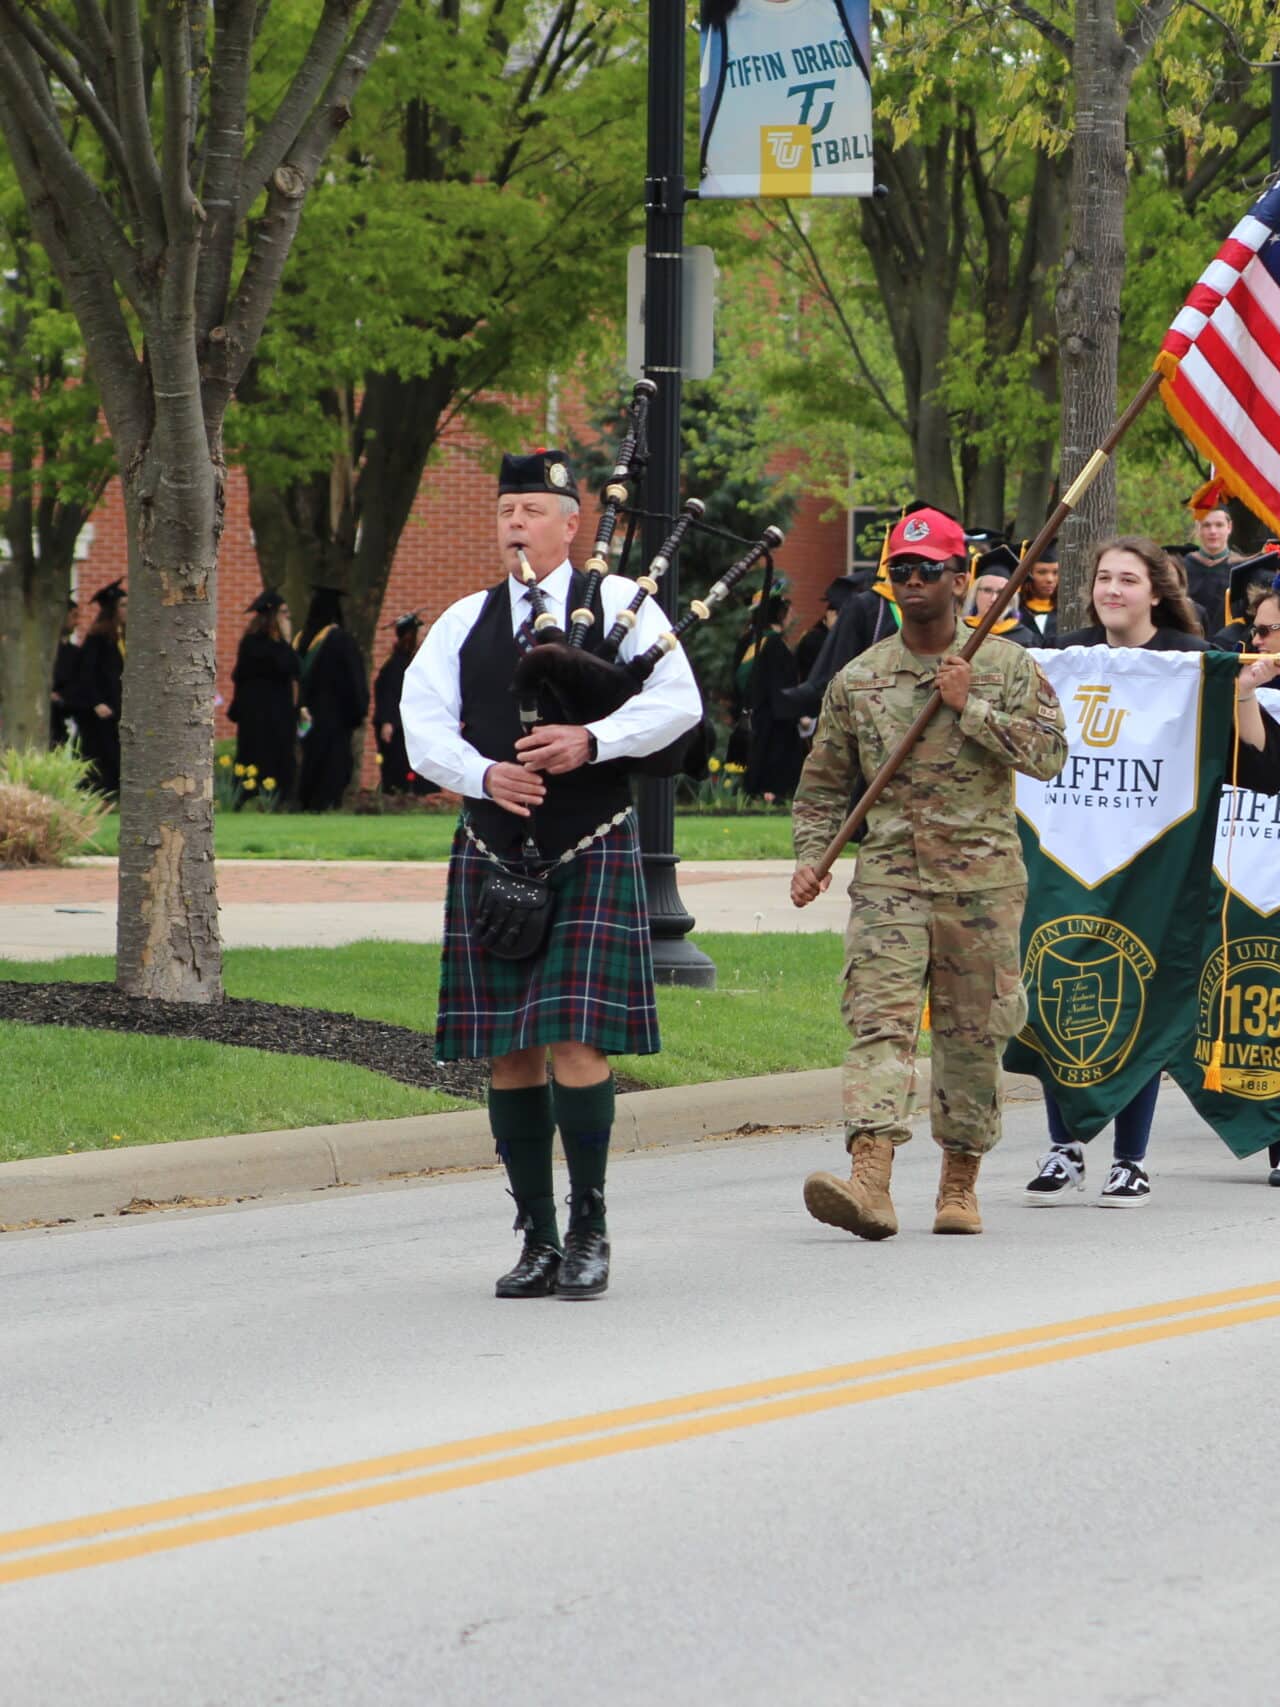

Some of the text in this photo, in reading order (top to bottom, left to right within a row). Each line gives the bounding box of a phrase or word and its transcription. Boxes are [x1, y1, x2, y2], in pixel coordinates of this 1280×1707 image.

[727, 53, 786, 88] TIFFIN
[1046, 755, 1164, 793] IFFIN
[1056, 1067, 1103, 1082] 1888
